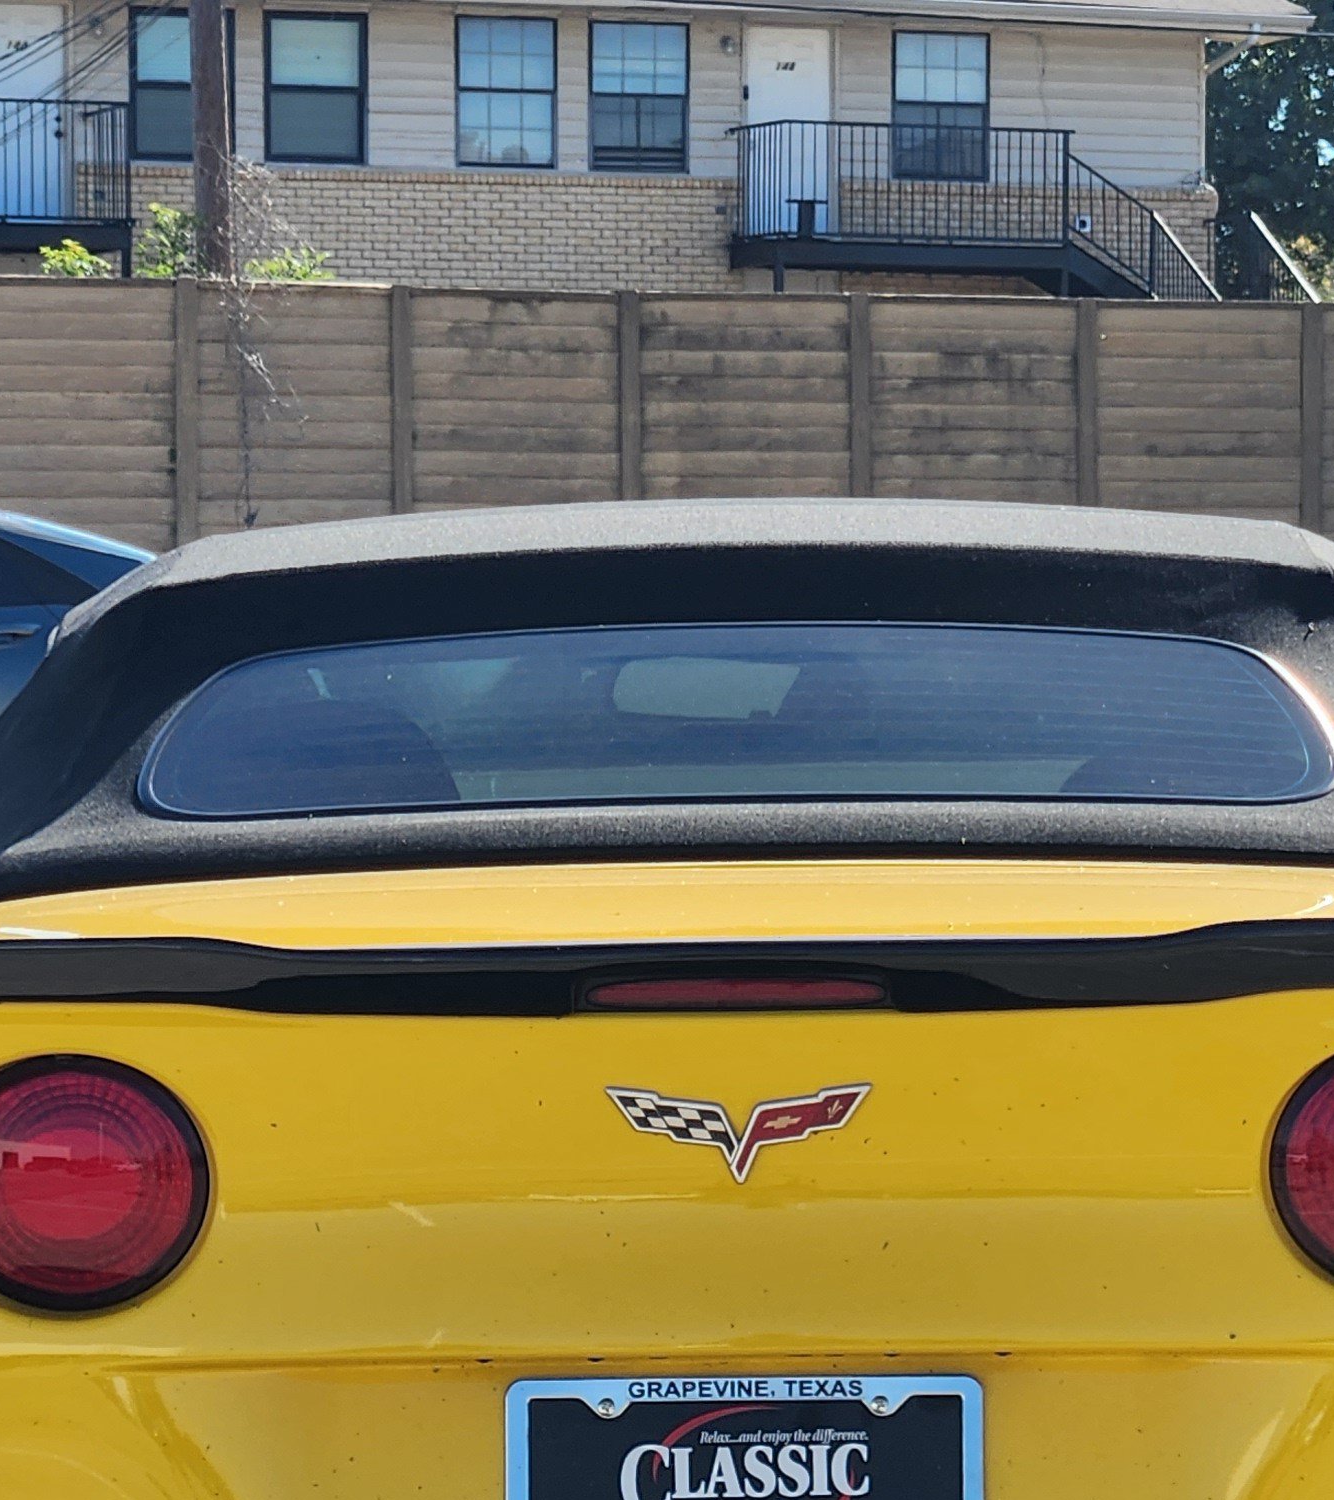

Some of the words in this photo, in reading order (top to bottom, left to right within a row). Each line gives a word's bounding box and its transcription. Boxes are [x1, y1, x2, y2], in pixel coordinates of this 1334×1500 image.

[628, 1380, 775, 1398] GRAPEVINE,
[783, 1379, 864, 1397] TEXAS
[765, 1431, 792, 1446] enjoy
[793, 1429, 811, 1443] the
[812, 1428, 870, 1445] difference.
